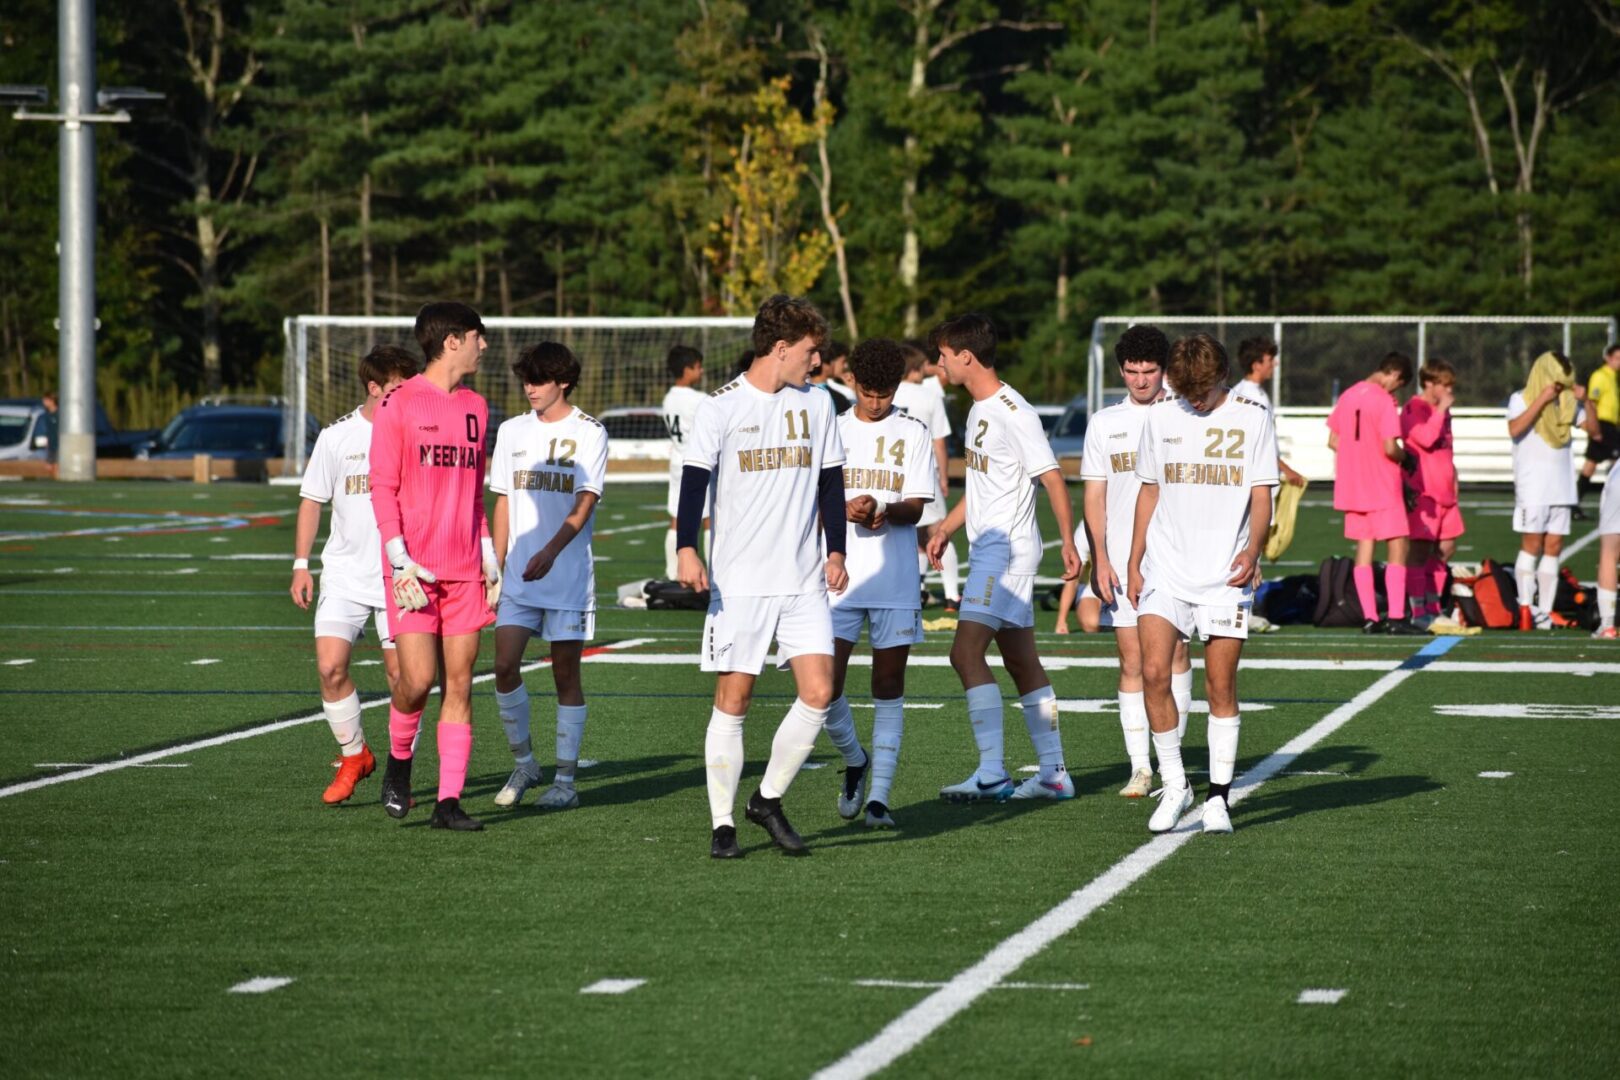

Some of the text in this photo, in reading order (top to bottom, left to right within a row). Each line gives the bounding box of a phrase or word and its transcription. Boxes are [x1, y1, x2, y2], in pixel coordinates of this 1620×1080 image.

[785, 409, 811, 440] 11
[975, 419, 989, 448] 2
[1355, 409, 1361, 441] 1
[546, 438, 577, 468] 12
[875, 436, 905, 466] 14
[1204, 427, 1245, 459] 22
[513, 469, 575, 494] NEEDHAM
[1164, 462, 1244, 487] NEEDHAM
